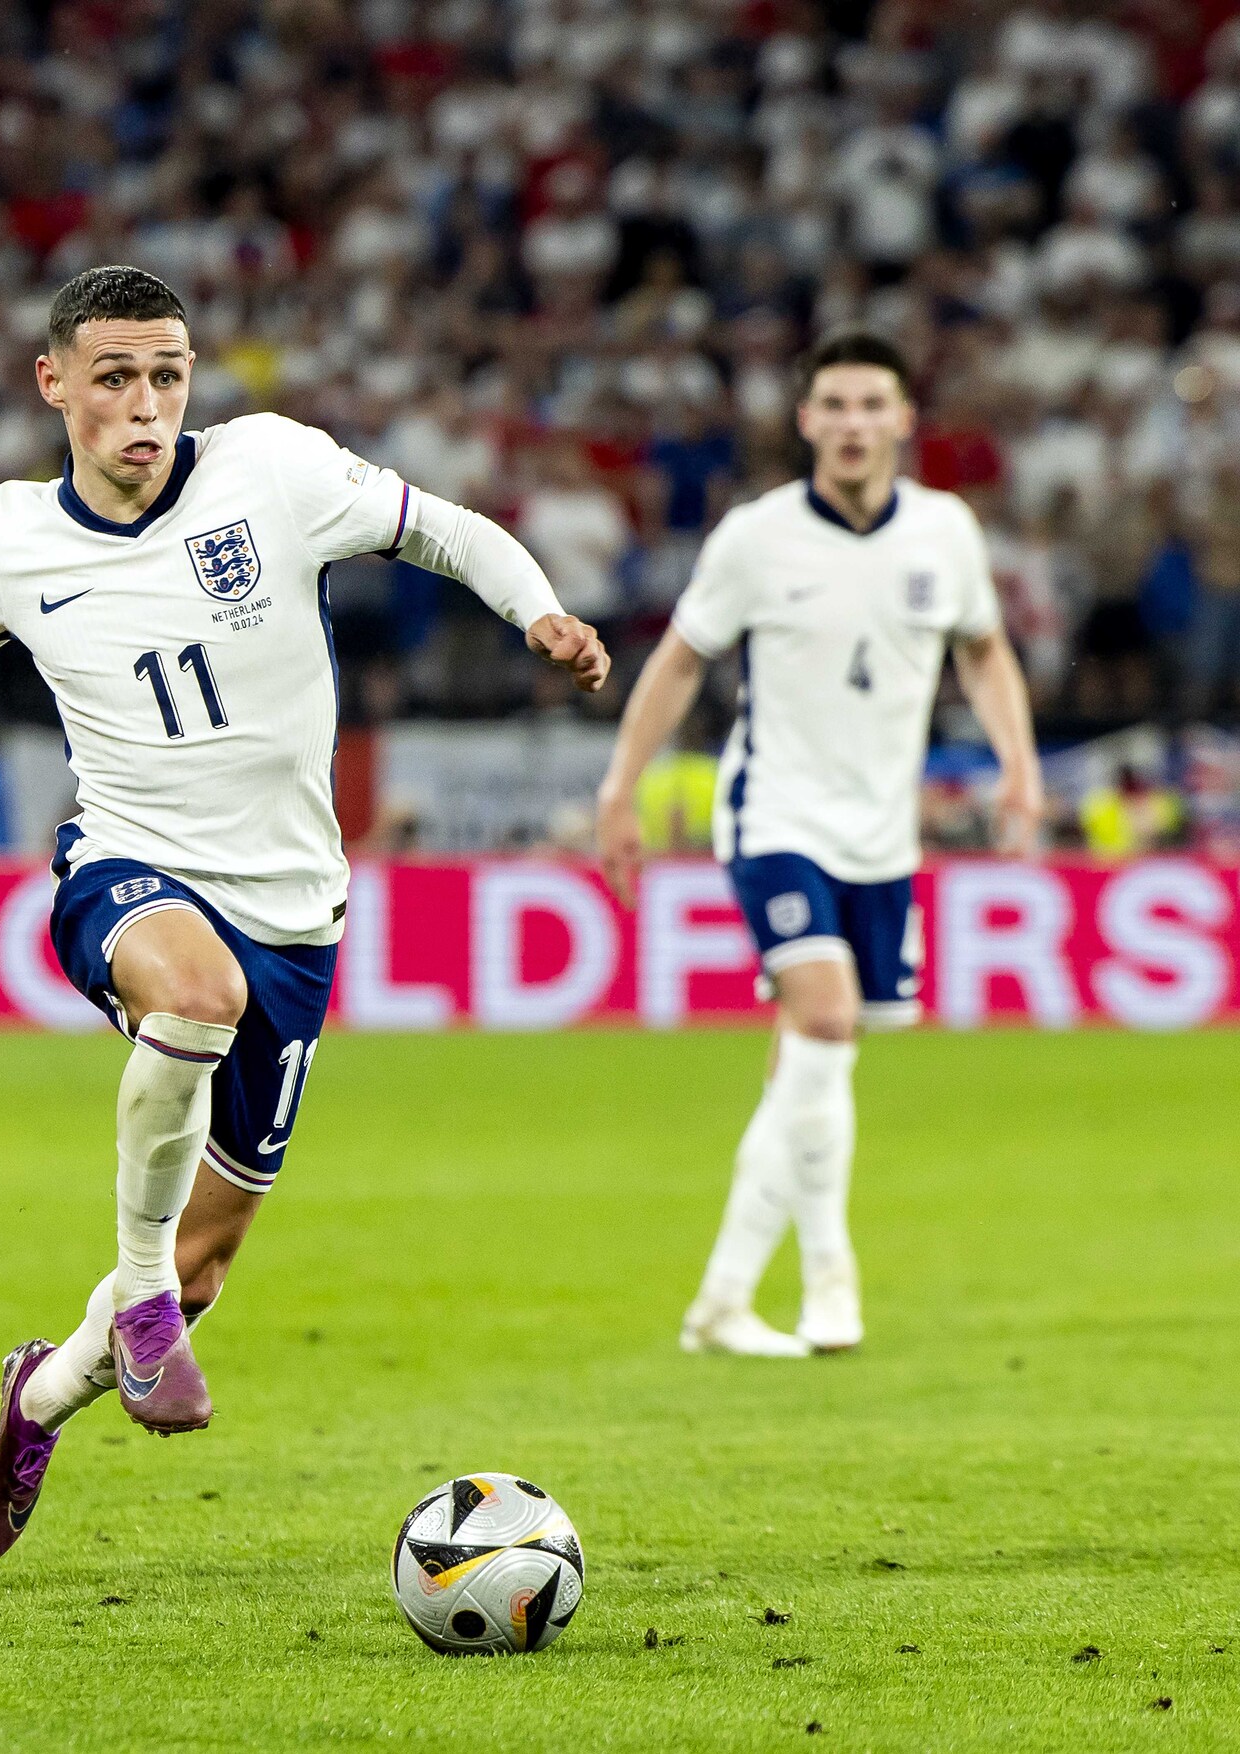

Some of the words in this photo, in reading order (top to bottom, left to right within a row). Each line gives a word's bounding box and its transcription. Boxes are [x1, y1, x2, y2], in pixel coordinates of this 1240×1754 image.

[211, 596, 273, 624] NETHERLANDS
[230, 613, 264, 632] 10.07.24
[133, 642, 230, 740] 11
